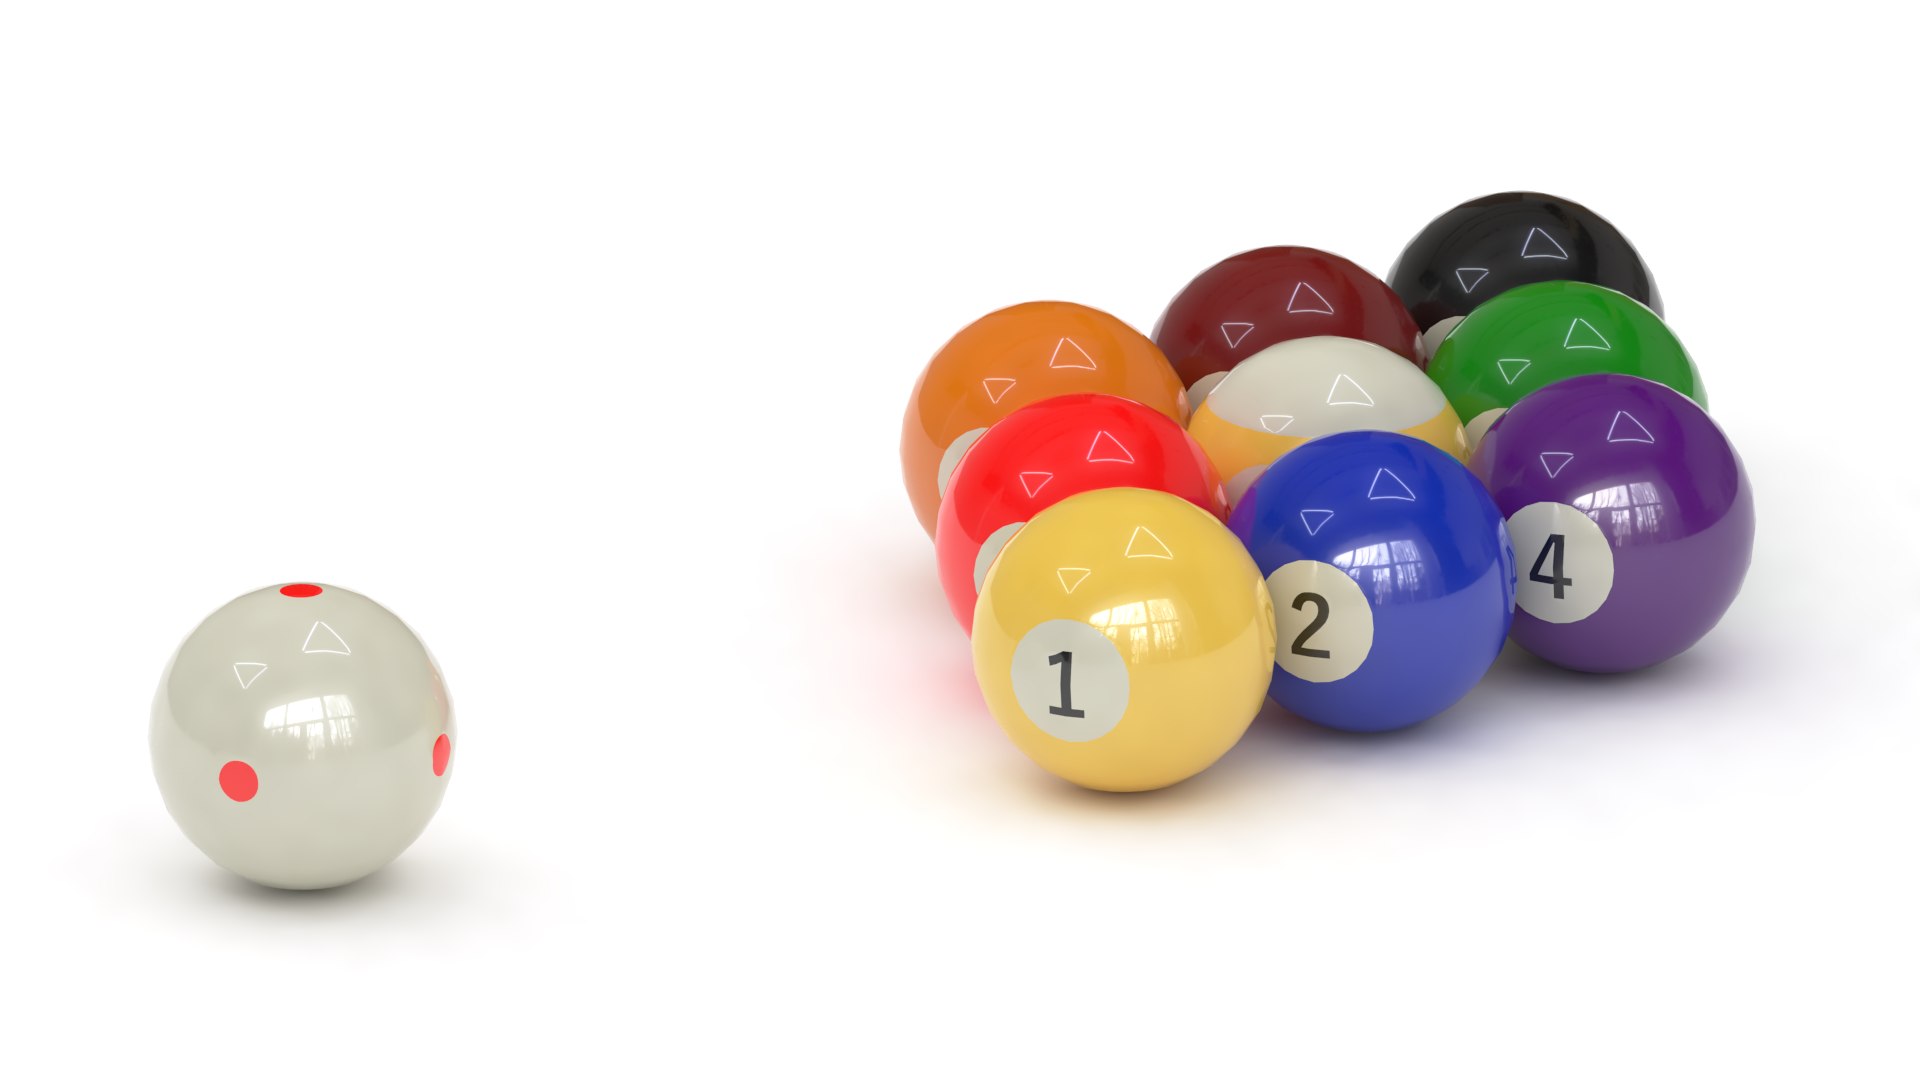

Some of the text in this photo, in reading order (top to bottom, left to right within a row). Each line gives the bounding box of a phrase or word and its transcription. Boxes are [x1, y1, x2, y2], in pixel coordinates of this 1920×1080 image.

[1529, 533, 1573, 600] 4
[1291, 592, 1331, 659] 2
[1048, 650, 1085, 719] 1
